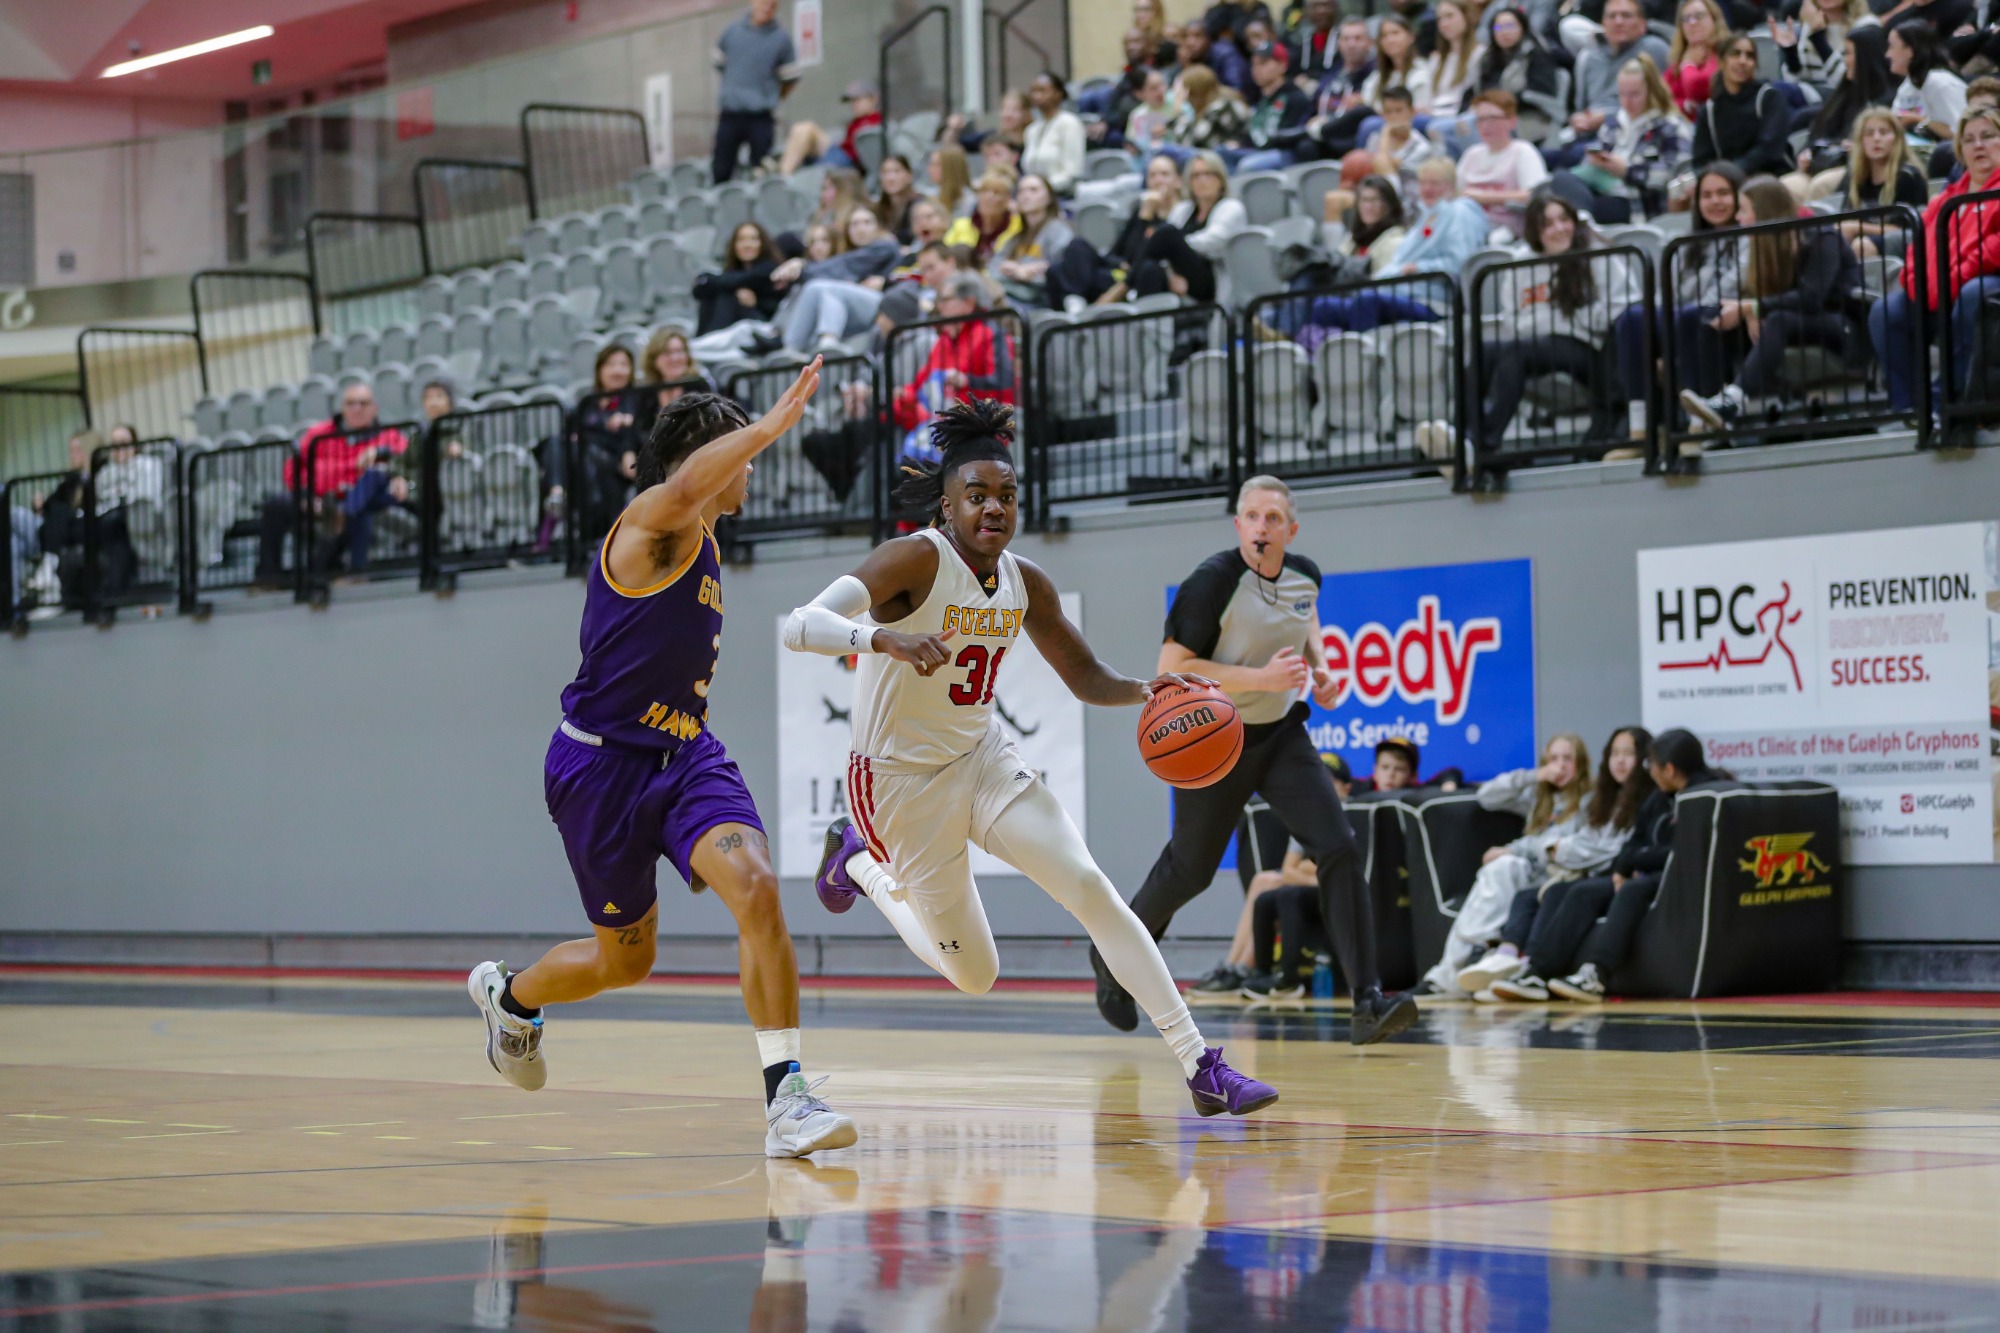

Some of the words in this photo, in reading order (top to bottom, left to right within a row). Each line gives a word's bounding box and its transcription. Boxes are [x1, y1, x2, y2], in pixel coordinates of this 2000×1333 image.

[1829, 573, 1976, 610] PREVENTION.
[1656, 584, 1756, 643] HPC
[1828, 611, 1949, 650] RECOVERY.
[948, 644, 1007, 706] 31
[1297, 595, 1500, 725] eedy
[1831, 654, 1931, 688] SUCCESS.
[639, 701, 709, 742] HAW
[1147, 705, 1218, 745] Wilson
[1304, 717, 1348, 751] uto
[1350, 715, 1429, 749] Service
[1707, 738, 1755, 764] Sports
[1758, 736, 1797, 758] Clinic
[1801, 734, 1817, 756] of
[1820, 733, 1844, 755] the
[1848, 731, 1902, 758] Guelph
[1905, 729, 1980, 756] Gryphons
[1954, 758, 1980, 771] MORE
[1917, 793, 1976, 814] HPCGuelph
